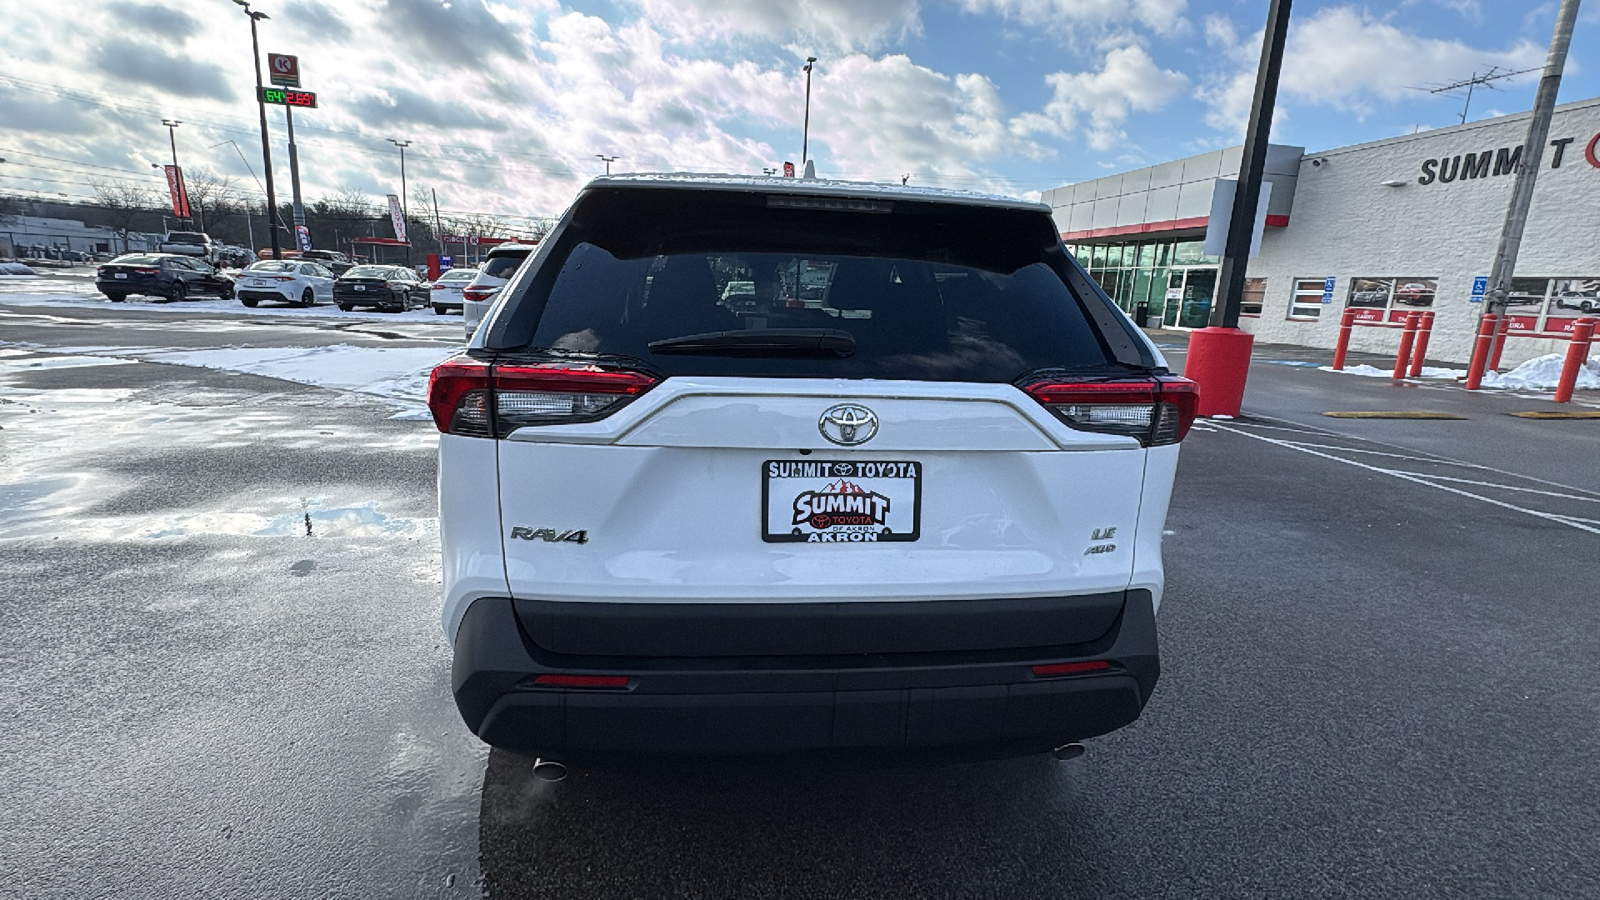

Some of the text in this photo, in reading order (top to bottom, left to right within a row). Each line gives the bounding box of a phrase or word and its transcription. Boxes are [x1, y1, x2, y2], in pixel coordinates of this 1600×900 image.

[1418, 137, 1574, 186] SUMMT
[443, 235, 469, 244] CIRCL
[768, 461, 917, 478] SUMMIT TOYOTA
[796, 494, 887, 522] SUMMIT
[832, 516, 872, 524] TOYOTA
[510, 525, 589, 545] RAV4
[807, 531, 878, 543] AKRON
[1090, 526, 1117, 541] LE
